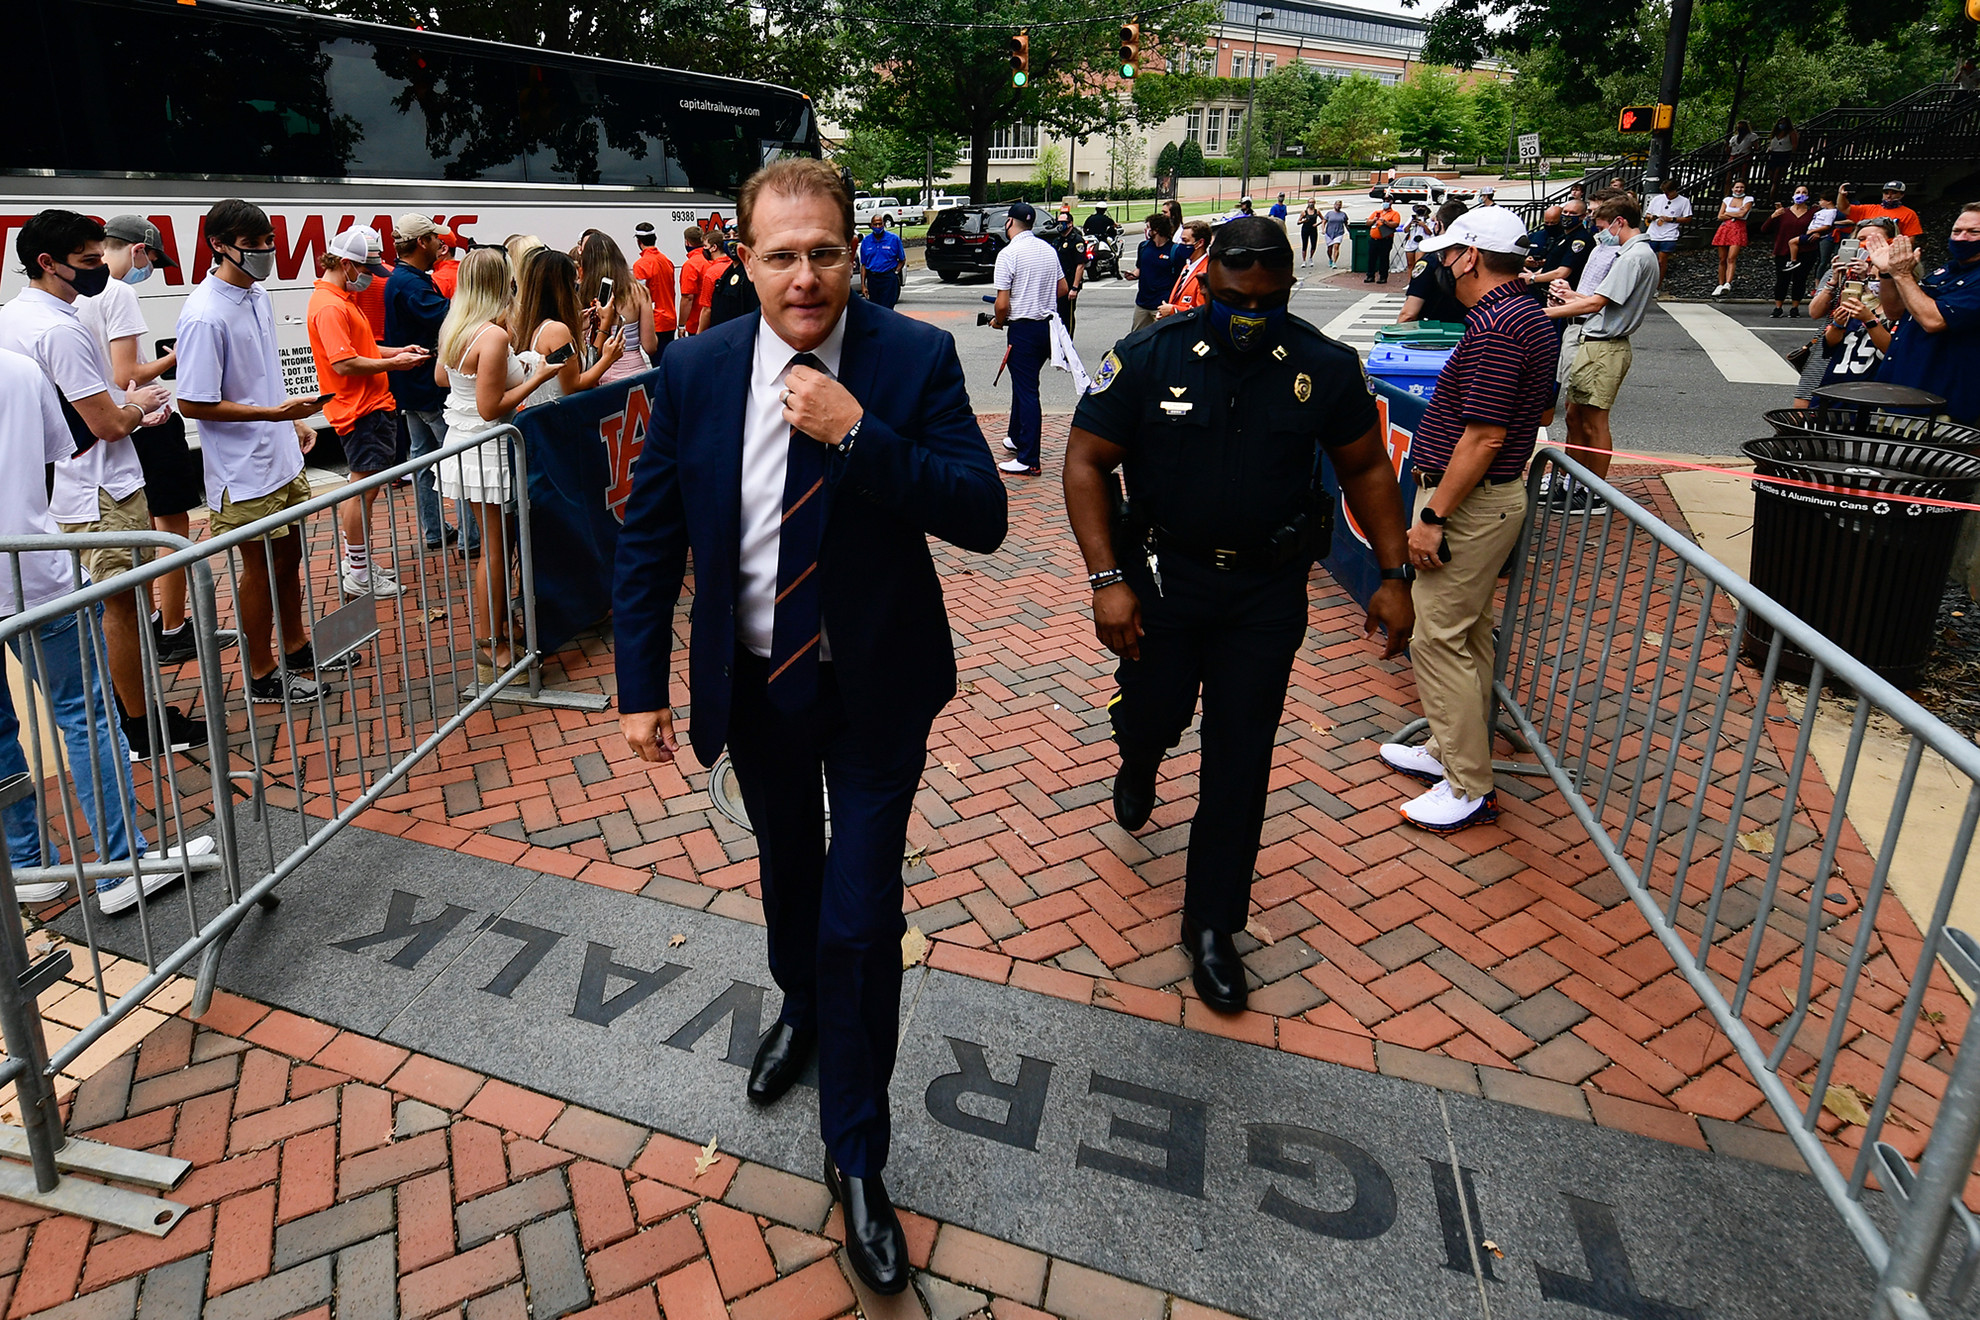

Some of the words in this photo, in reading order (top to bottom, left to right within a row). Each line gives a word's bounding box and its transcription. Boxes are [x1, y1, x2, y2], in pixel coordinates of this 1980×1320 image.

[680, 99, 760, 116] capitaltrailways.com
[1521, 146, 1536, 156] 30
[671, 211, 695, 221] 99388
[1833, 332, 1876, 374] 15
[287, 367, 301, 376] DOT
[303, 365, 316, 374] 105
[295, 375, 315, 385] CERT.
[300, 384, 319, 394] CLAS
[1759, 482, 1779, 495] Bottles
[1788, 491, 1837, 507] Aluminum
[1839, 500, 1868, 511] Cans
[924, 1036, 1704, 1320] TIGER
